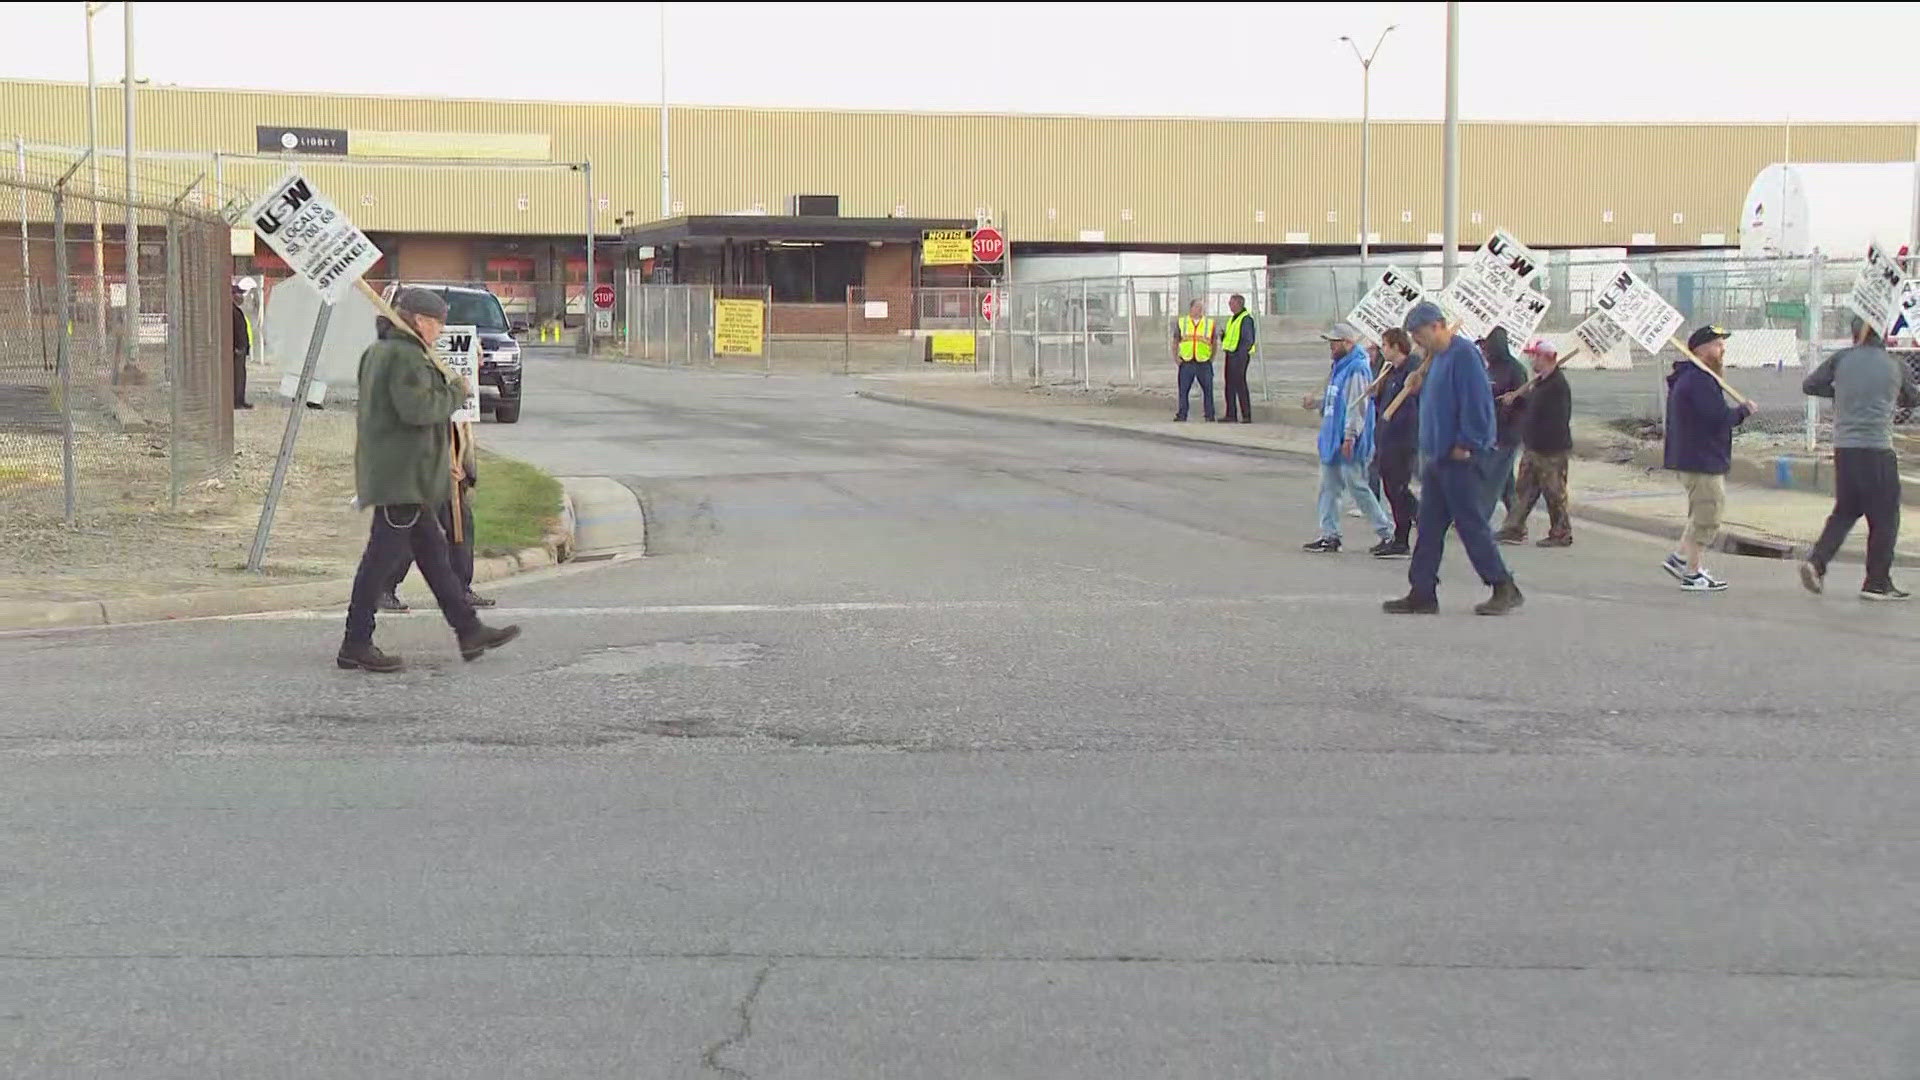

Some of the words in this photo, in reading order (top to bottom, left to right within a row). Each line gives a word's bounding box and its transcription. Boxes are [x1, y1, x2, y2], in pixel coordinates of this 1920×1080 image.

[255, 177, 312, 236] USW
[280, 202, 323, 244] LOCALS
[973, 239, 1001, 253] STOP
[1486, 235, 1534, 278] USW
[594, 293, 614, 302] STOP
[1381, 270, 1418, 302] USW
[1597, 270, 1634, 310] USW
[599, 320, 609, 328] 10
